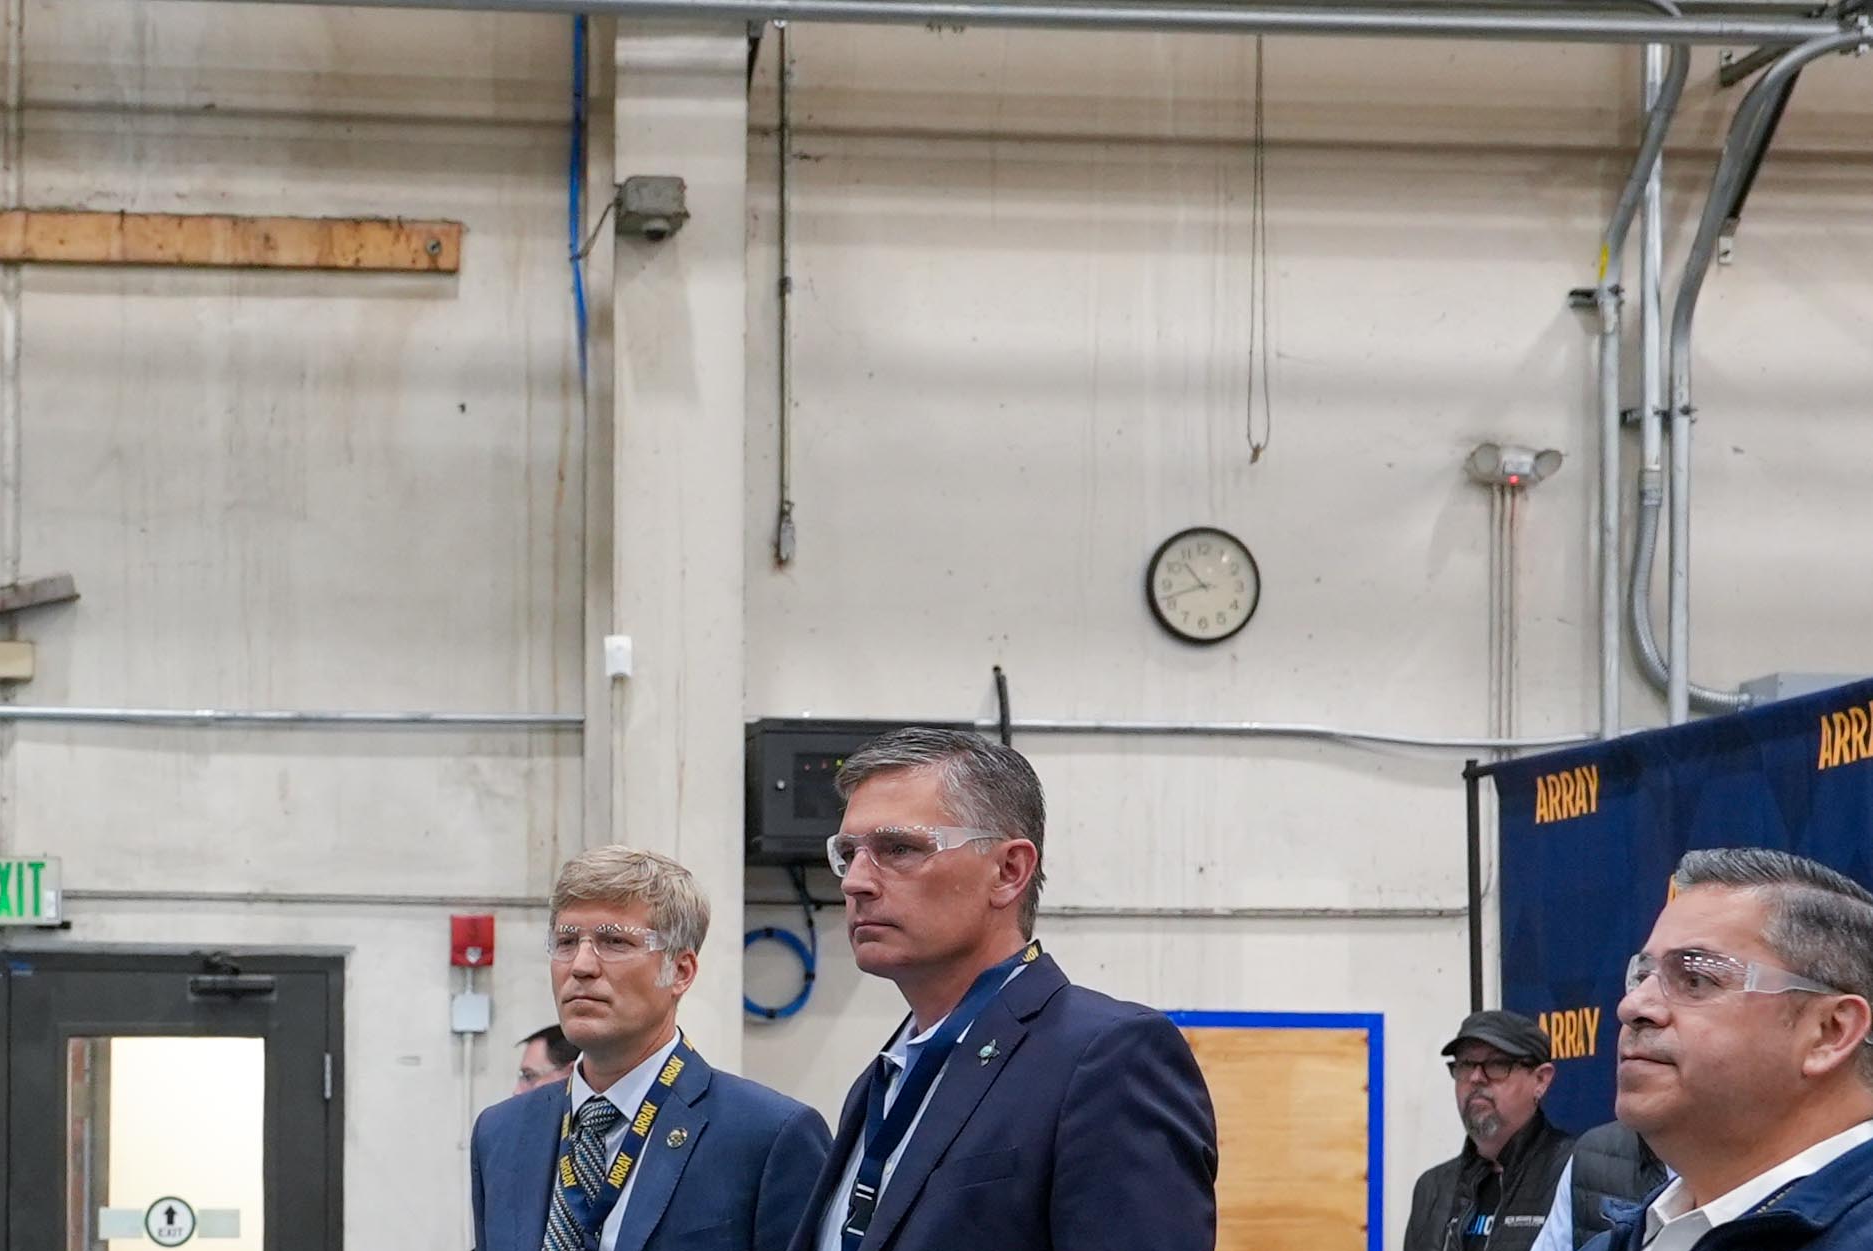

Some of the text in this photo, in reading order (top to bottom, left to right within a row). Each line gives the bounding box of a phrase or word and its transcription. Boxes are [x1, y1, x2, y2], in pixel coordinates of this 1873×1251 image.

[1535, 764, 1599, 825] ARRAY
[658, 1054, 686, 1087] ARRAY
[631, 1100, 658, 1137] ARRAY
[559, 1154, 577, 1189] ARRAY
[607, 1151, 634, 1189] ARRAY
[158, 1227, 184, 1238] EXIT
